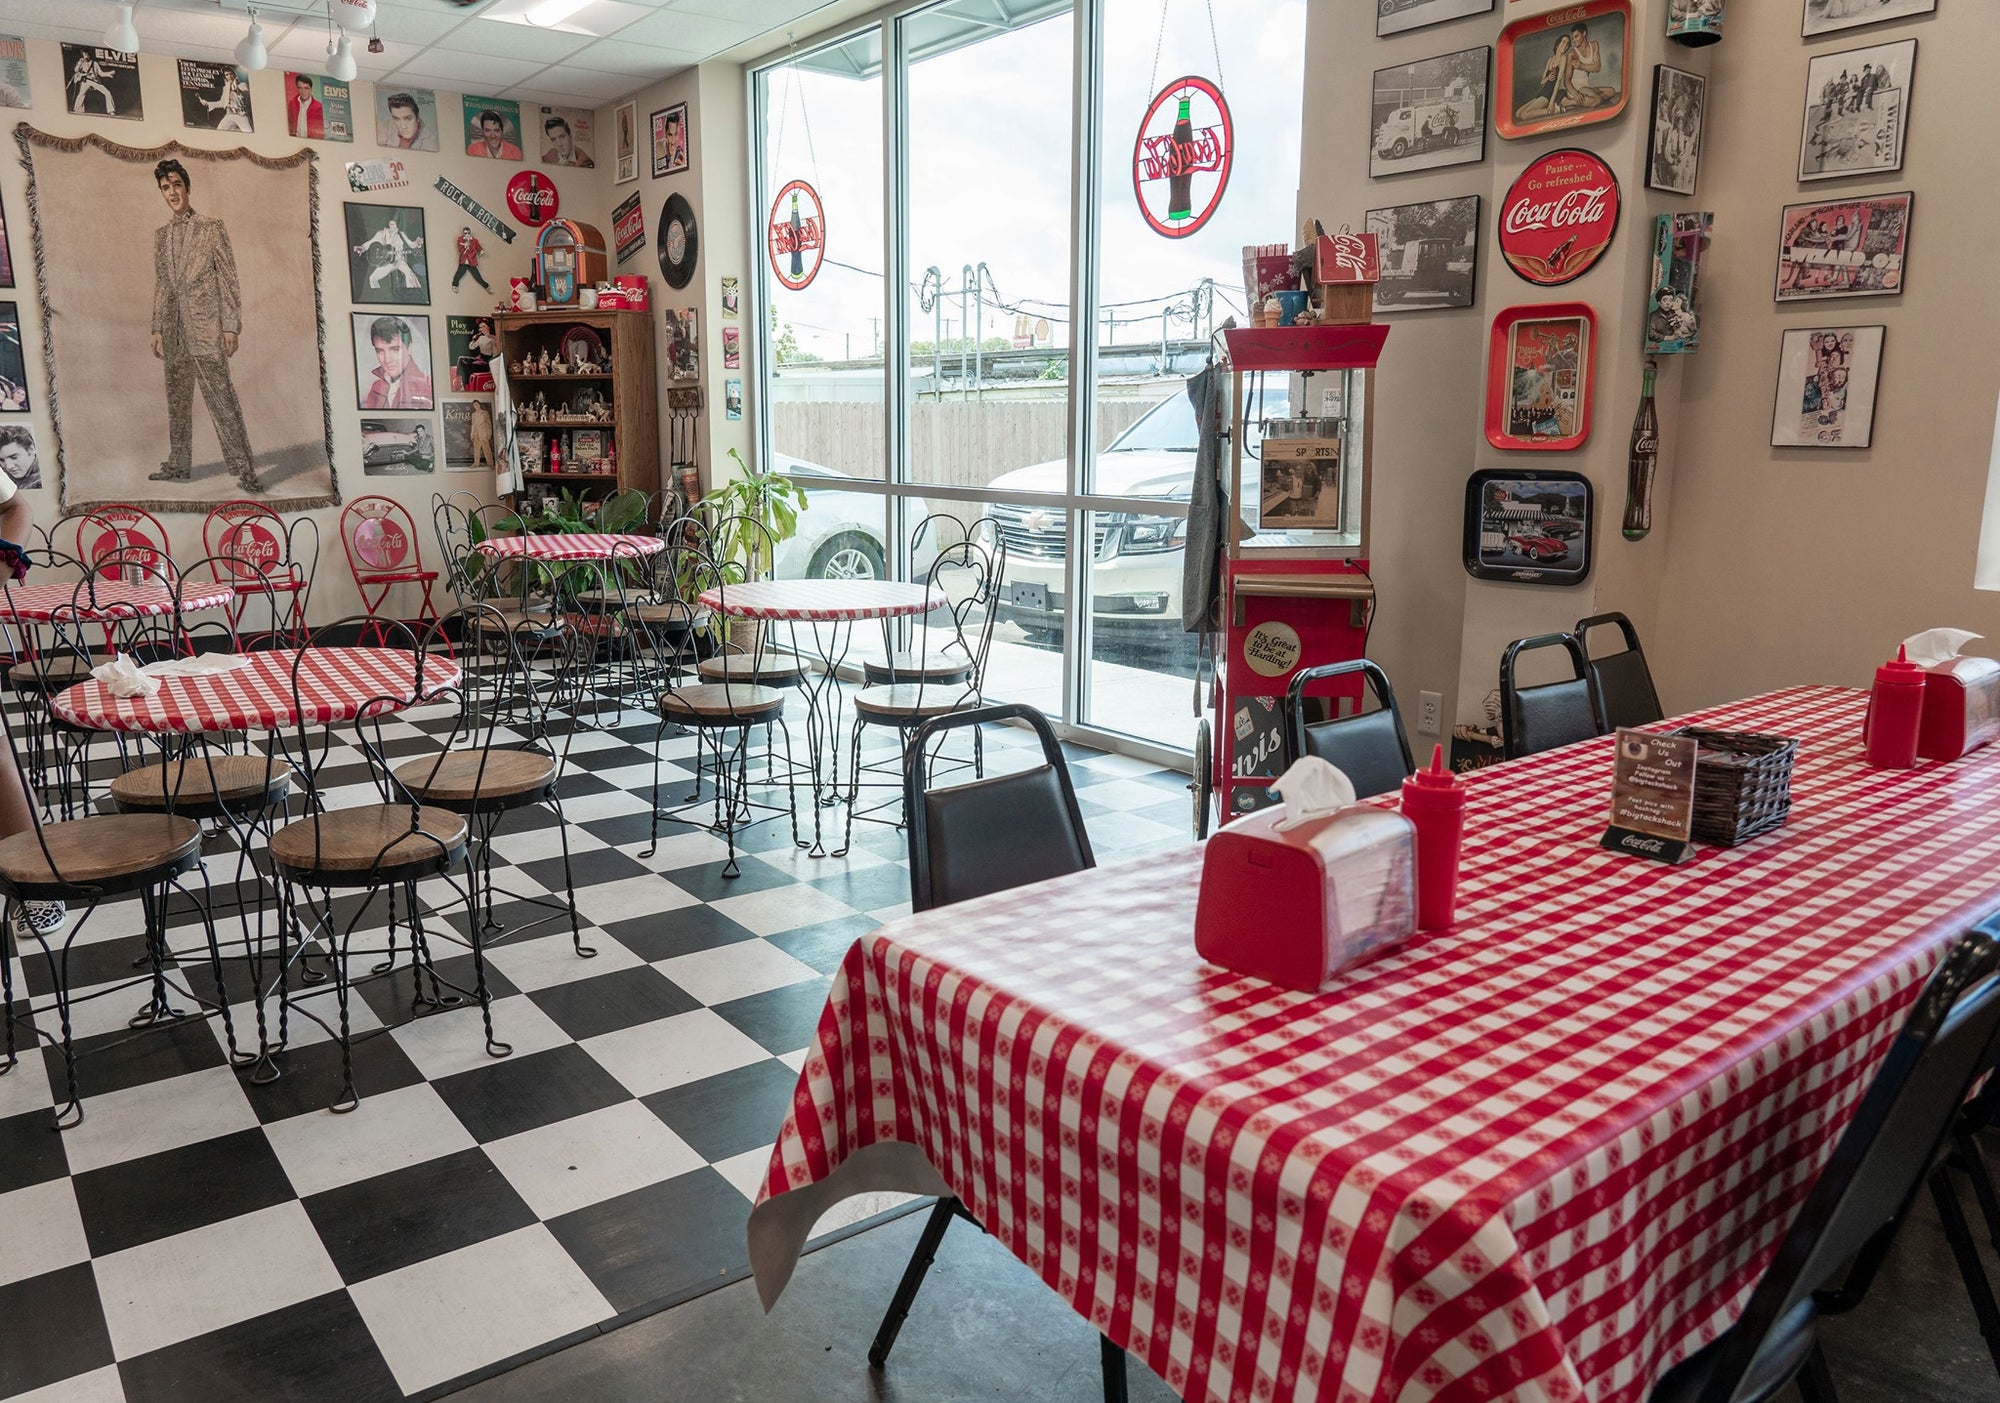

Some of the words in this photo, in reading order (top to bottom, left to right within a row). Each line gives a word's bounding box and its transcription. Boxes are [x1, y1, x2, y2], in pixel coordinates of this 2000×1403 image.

[95, 48, 137, 63] ELVIS
[324, 85, 348, 99] ELVIS
[1528, 179, 1542, 191] Go
[1546, 171, 1593, 188] refreshed
[513, 187, 554, 206] Coca-Cola
[1506, 183, 1615, 234] Coca-Cola
[450, 320, 467, 330] Play
[445, 409, 471, 422] King
[1252, 639, 1261, 649] to
[1262, 642, 1276, 653] be
[1277, 648, 1287, 657] at
[1253, 630, 1268, 644] It's
[1271, 634, 1297, 653] Great
[1248, 647, 1292, 670] Harding!
[1650, 738, 1677, 749] Check
[1232, 727, 1282, 777] lvis
[1657, 749, 1669, 757] Us
[1636, 764, 1672, 776] Instagram
[1664, 758, 1683, 768] Out
[1634, 770, 1656, 780] Follow
[1643, 799, 1658, 808] pics
[1660, 803, 1675, 811] with
[1620, 834, 1666, 854] Coca-Cola
